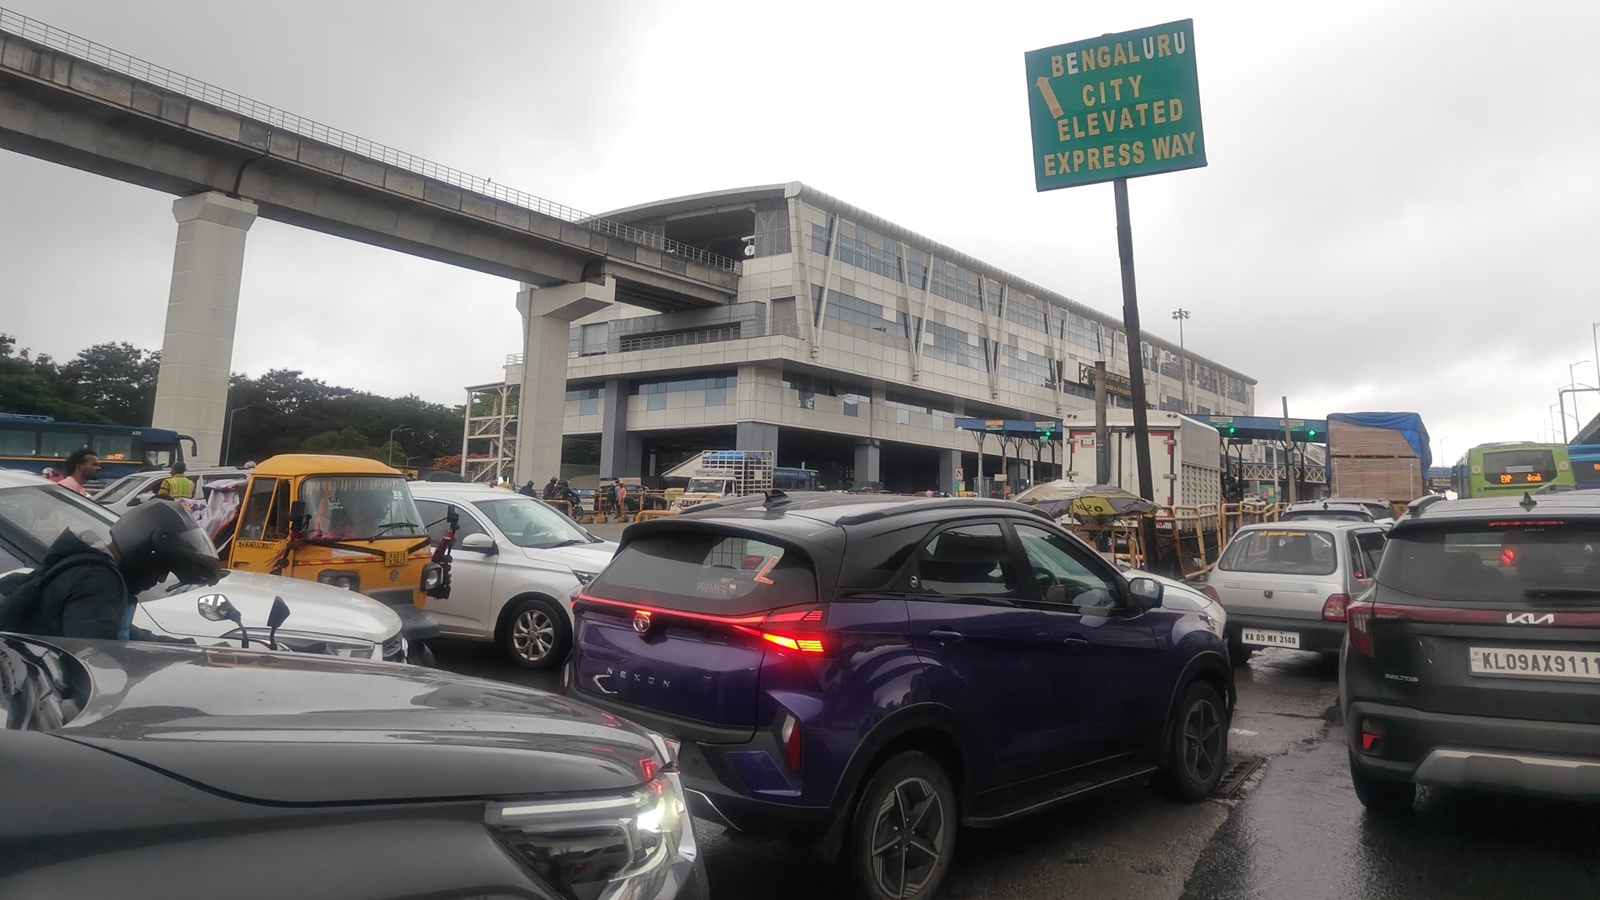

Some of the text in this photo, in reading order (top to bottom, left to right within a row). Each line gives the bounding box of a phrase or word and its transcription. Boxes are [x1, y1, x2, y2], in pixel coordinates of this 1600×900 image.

[1051, 31, 1186, 78] BENGALURU
[1082, 74, 1142, 107] CITY
[1057, 98, 1183, 142] ELEVATED
[1044, 131, 1195, 177] EXPRESS WAY
[1506, 613, 1555, 624] KIA
[1245, 633, 1254, 641] KA
[1256, 634, 1265, 642] 05
[1279, 636, 1296, 644] 3140
[1482, 652, 1600, 674] KL09AX9111
[606, 667, 671, 687] NEXON
